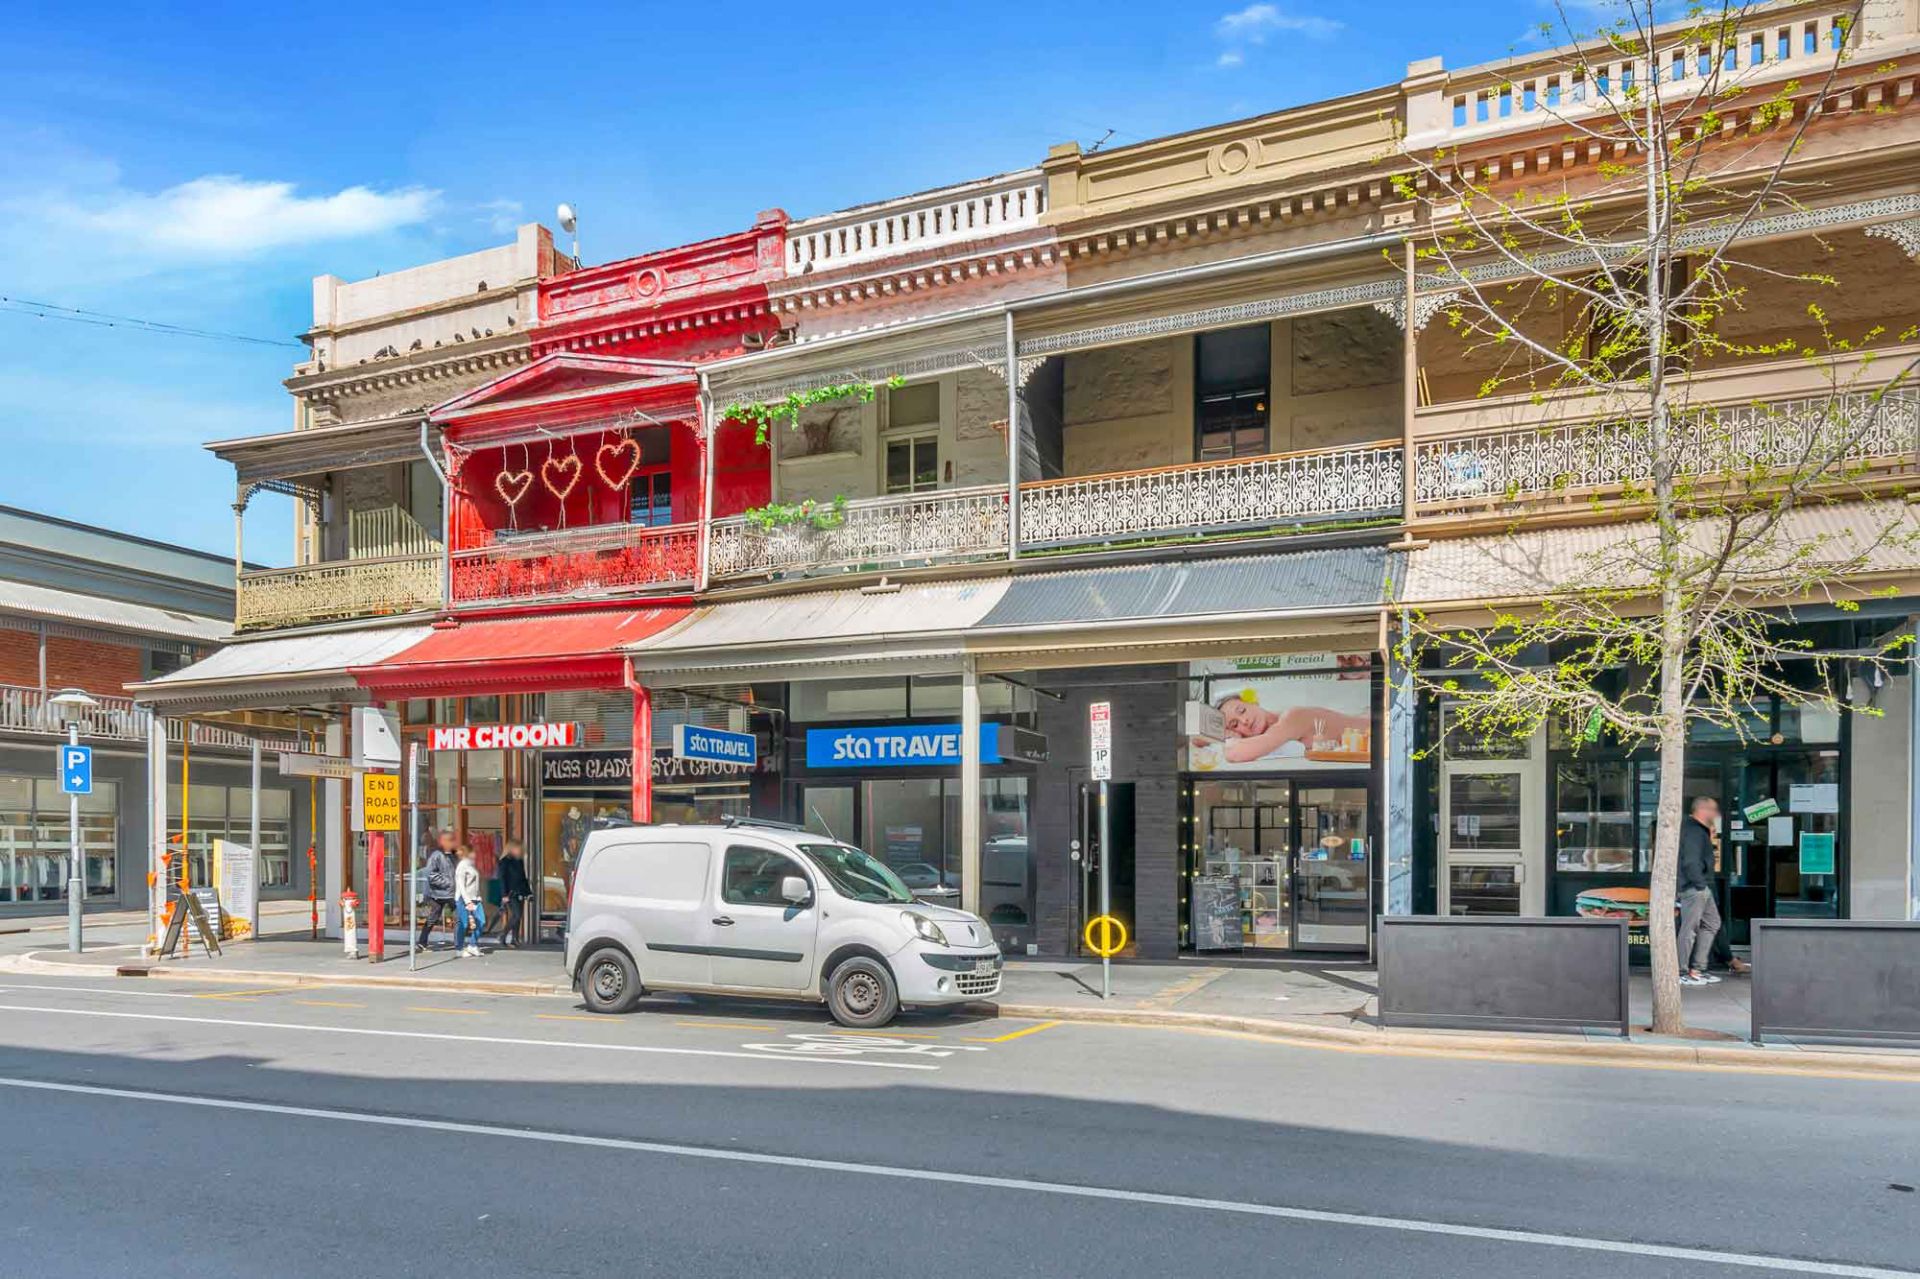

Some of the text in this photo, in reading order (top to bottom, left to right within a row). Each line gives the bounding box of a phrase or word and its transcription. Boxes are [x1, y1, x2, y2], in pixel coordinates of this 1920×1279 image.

[1287, 654, 1325, 664] Facial
[434, 723, 567, 750] MR CHOON
[709, 737, 750, 757] TRAVEL
[875, 734, 963, 758] TRAVE
[68, 751, 86, 769] P
[545, 759, 581, 779] MISS
[585, 758, 633, 778] GLADY
[652, 757, 685, 776] SYM
[369, 780, 394, 790] END
[366, 798, 398, 807] ROAD
[366, 814, 399, 825] WORK
